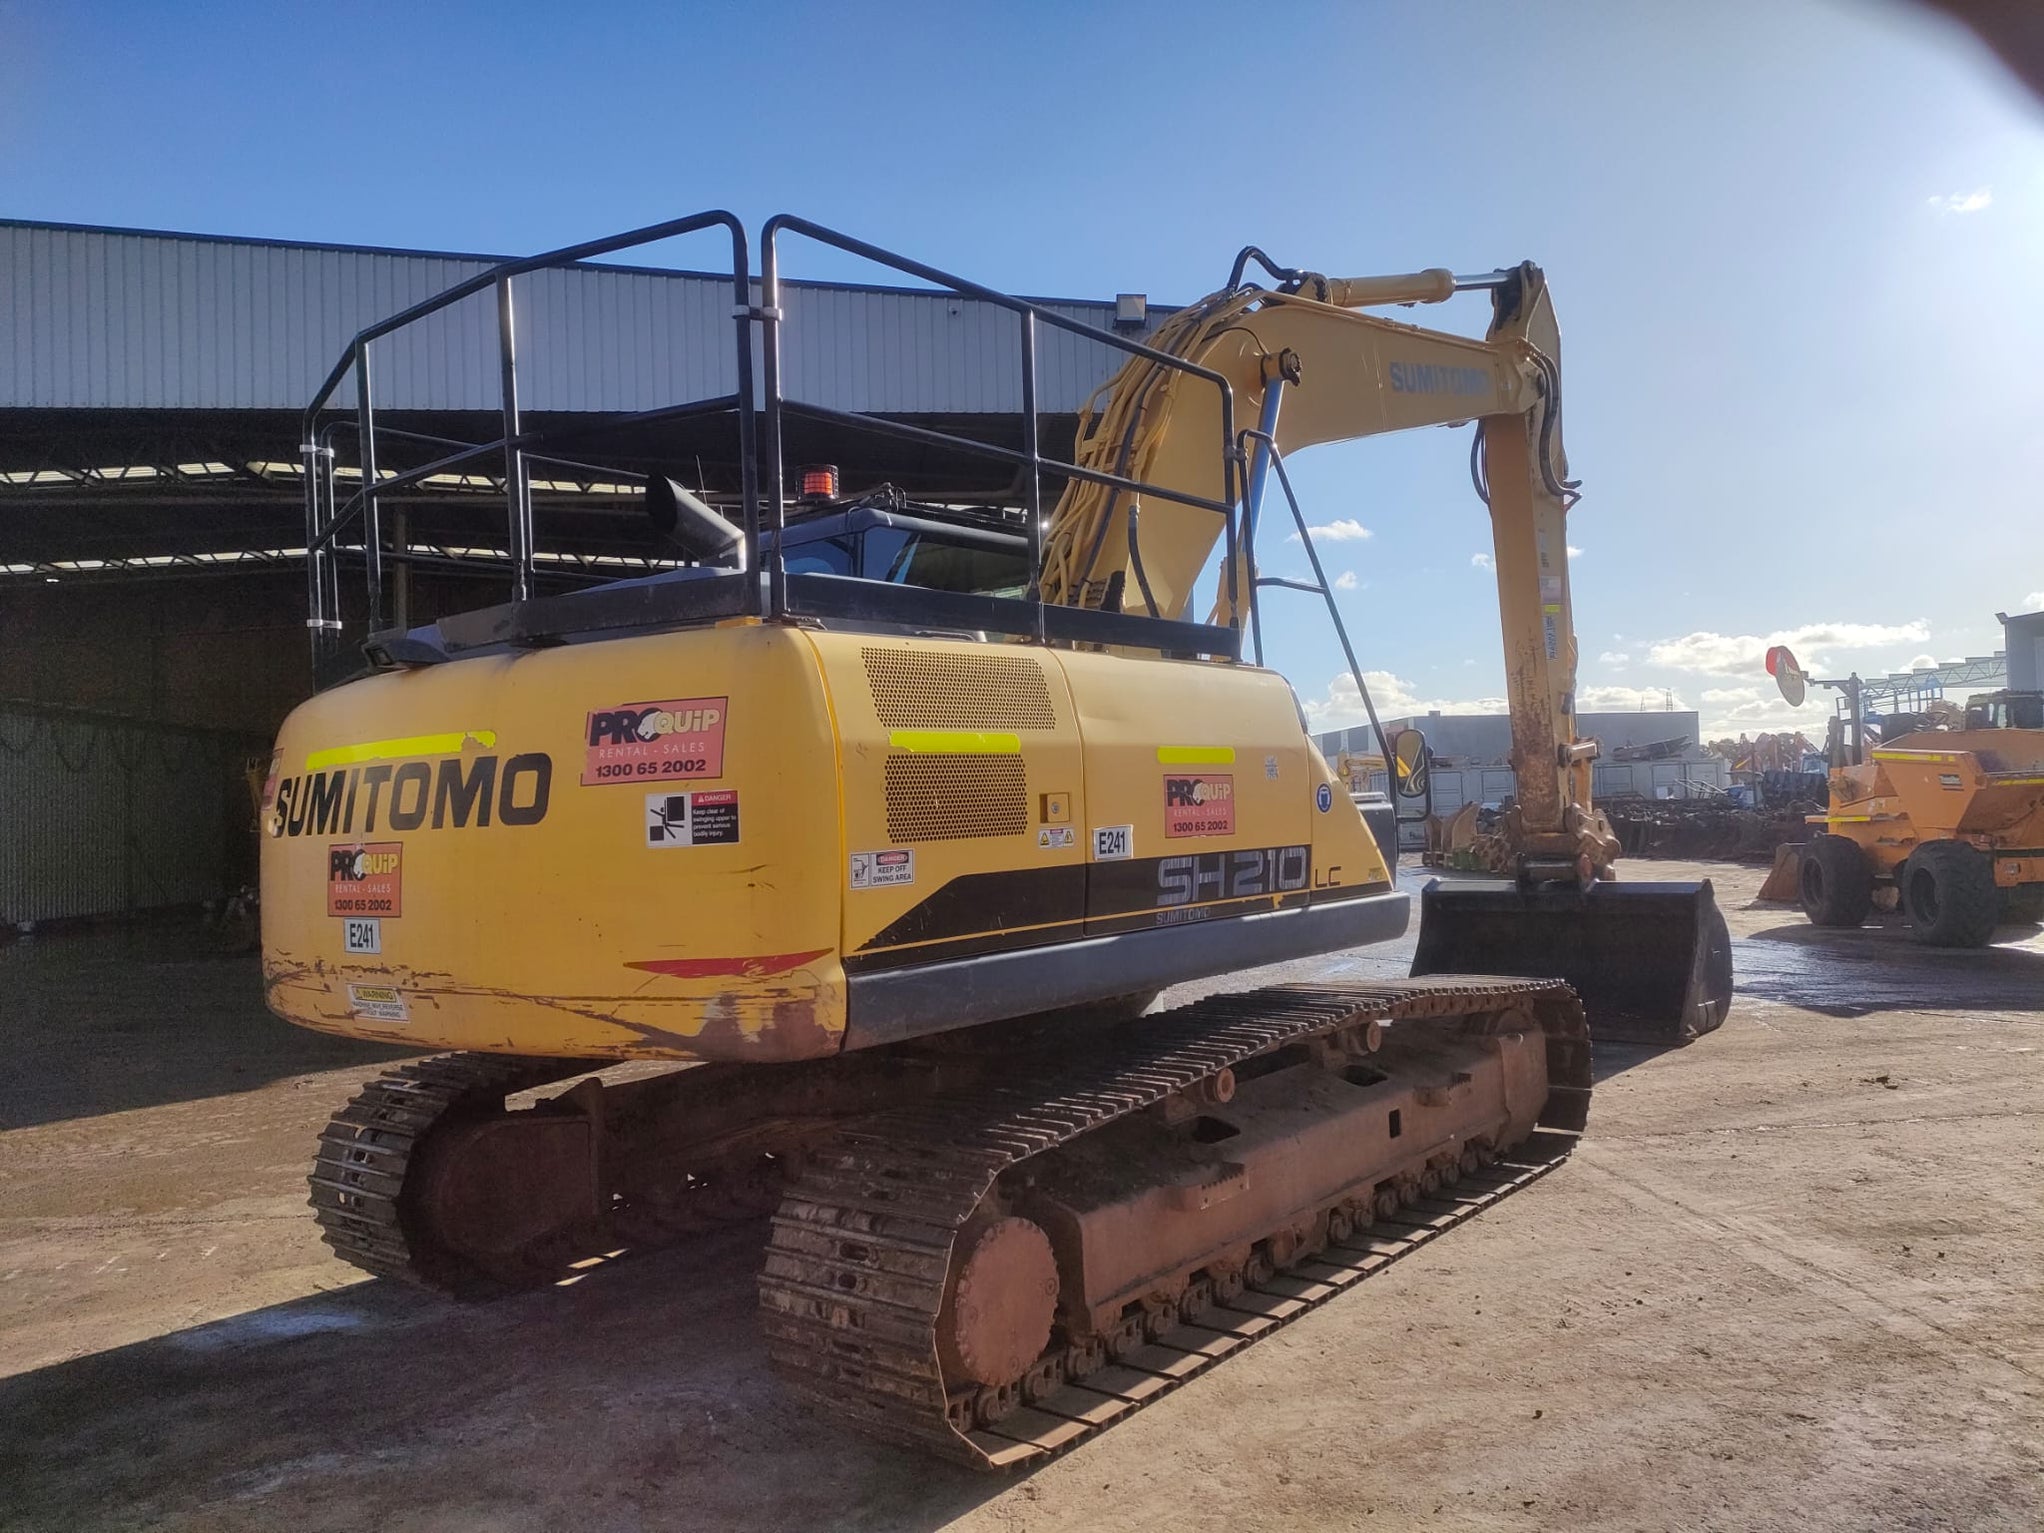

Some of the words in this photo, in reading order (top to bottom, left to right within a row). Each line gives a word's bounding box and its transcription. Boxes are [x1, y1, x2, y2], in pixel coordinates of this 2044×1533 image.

[599, 746, 648, 759] RENTAL
[663, 742, 705, 754] SALES
[596, 764, 633, 778] 1300
[636, 762, 658, 775] 65
[661, 759, 706, 774] 2002
[273, 752, 552, 838] SUMITOMO
[704, 794, 732, 802] DANGER
[1173, 822, 1194, 832] 1300
[1195, 821, 1206, 831] 65
[1207, 820, 1228, 831] 2002
[1099, 831, 1125, 854] E241
[878, 865, 894, 874] KEEP
[894, 864, 907, 873] OFF
[873, 874, 894, 883] SWING
[895, 873, 911, 881] AREA
[1315, 865, 1342, 889] LC
[367, 883, 392, 892] SALES
[335, 899, 354, 911] 1300
[354, 899, 366, 910] 65
[367, 899, 392, 911] 2002
[349, 923, 374, 949] E241
